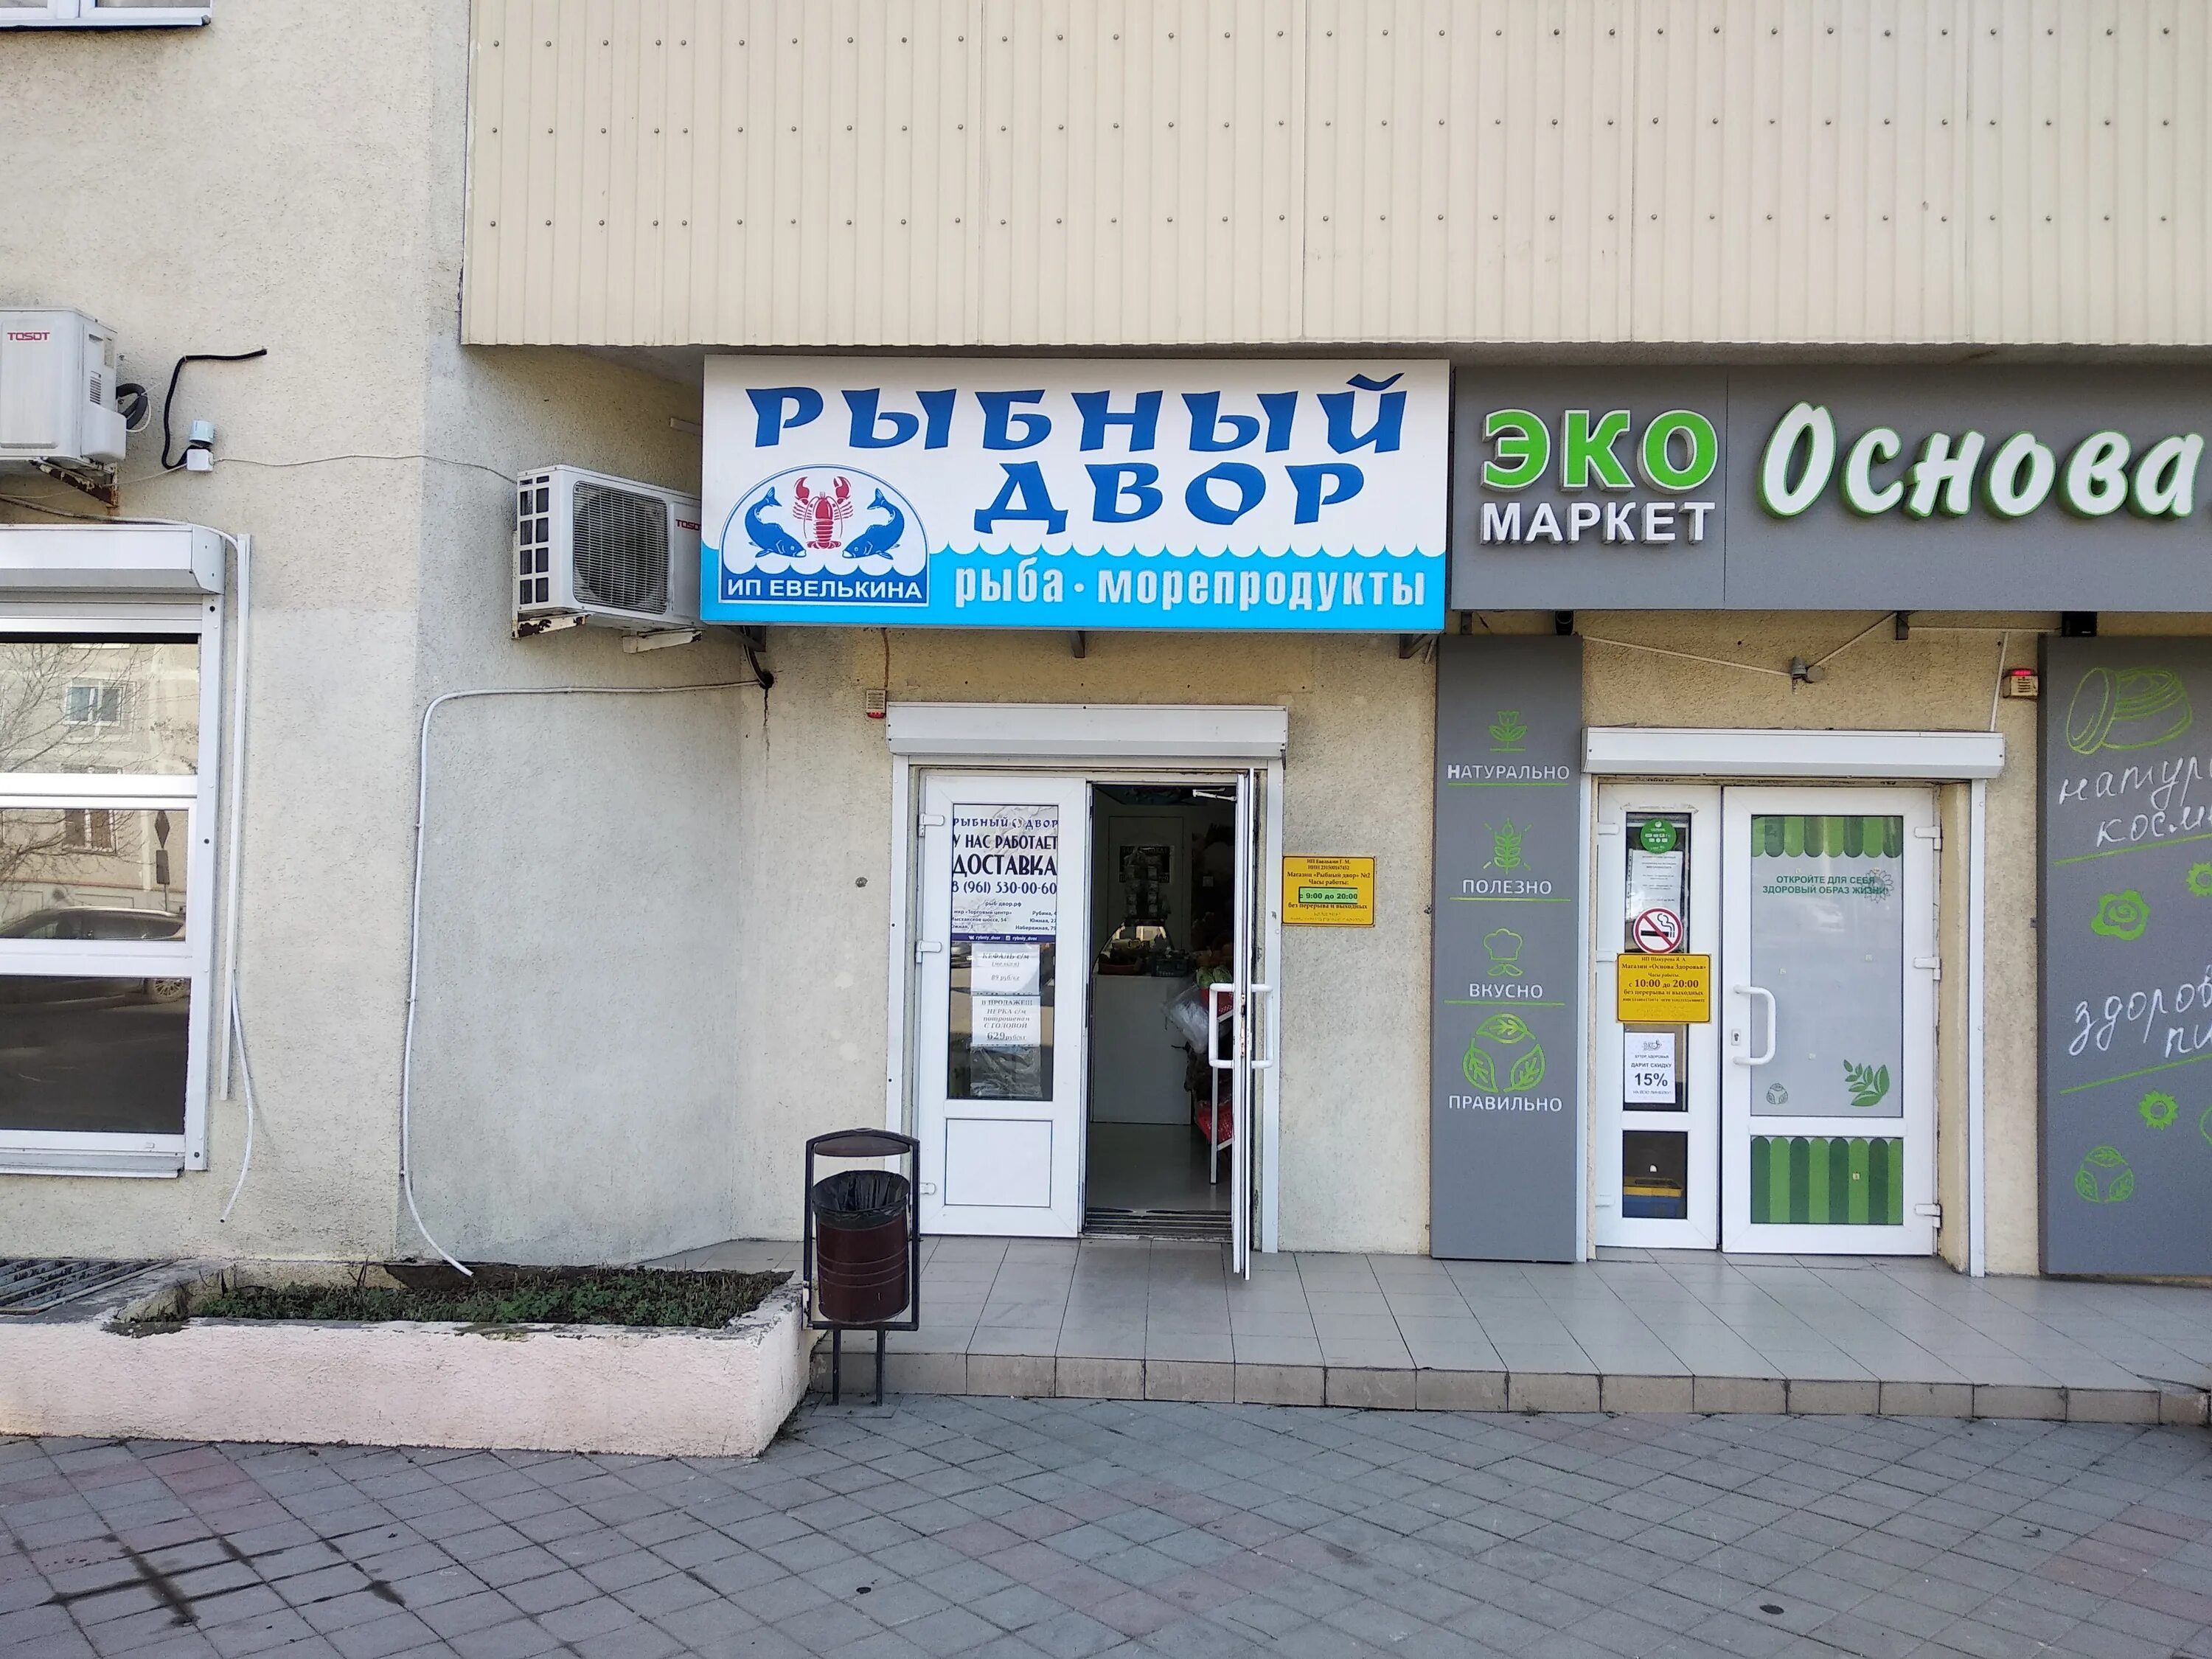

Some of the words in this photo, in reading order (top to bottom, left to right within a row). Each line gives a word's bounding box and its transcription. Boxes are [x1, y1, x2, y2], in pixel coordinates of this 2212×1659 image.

[7, 332, 50, 341] TOSOT
[745, 373, 1408, 455] РЫБНЫЙ
[1480, 408, 1719, 494] ЭКО
[1756, 400, 2205, 520] Основа
[974, 461, 1365, 535] ДВОР
[675, 518, 701, 531] TOSO
[1481, 501, 1715, 545] МАРКЕТ
[728, 579, 761, 596] ИП
[770, 580, 922, 598] ЕВЕЛЬКИНА
[955, 557, 1065, 608] рыба
[1097, 568, 1425, 612] морепродукты
[1447, 764, 1570, 779] НАТУРАЛЬНО
[2059, 757, 2212, 811] натур
[953, 817, 1008, 827] РЫБНЫЙ
[1025, 820, 1058, 830] ДВОР
[953, 834, 961, 847] У
[965, 835, 990, 848] НАС
[995, 835, 1057, 849] РАБОТАЕТ
[953, 854, 1057, 877] ДОСТАВКА
[952, 880, 959, 892] 8
[964, 880, 991, 894] (961)
[995, 881, 1057, 894] 530-00-60
[1462, 879, 1552, 894] ПОЛЕЗНО
[1776, 874, 1825, 884] ОТКРОЙТЕ
[1827, 876, 1847, 885] ДЛЯ
[1762, 884, 1816, 894] ЗДОРОВЫЙ
[1819, 886, 1849, 894] ОБРАЗ
[1469, 983, 1543, 998] ВКУСНО
[1635, 979, 1660, 987] 10:00
[1673, 979, 1699, 988] 20:00
[1635, 1073, 1668, 1087] 15%
[1449, 1095, 1562, 1111] ПРАВИЛЬНО
